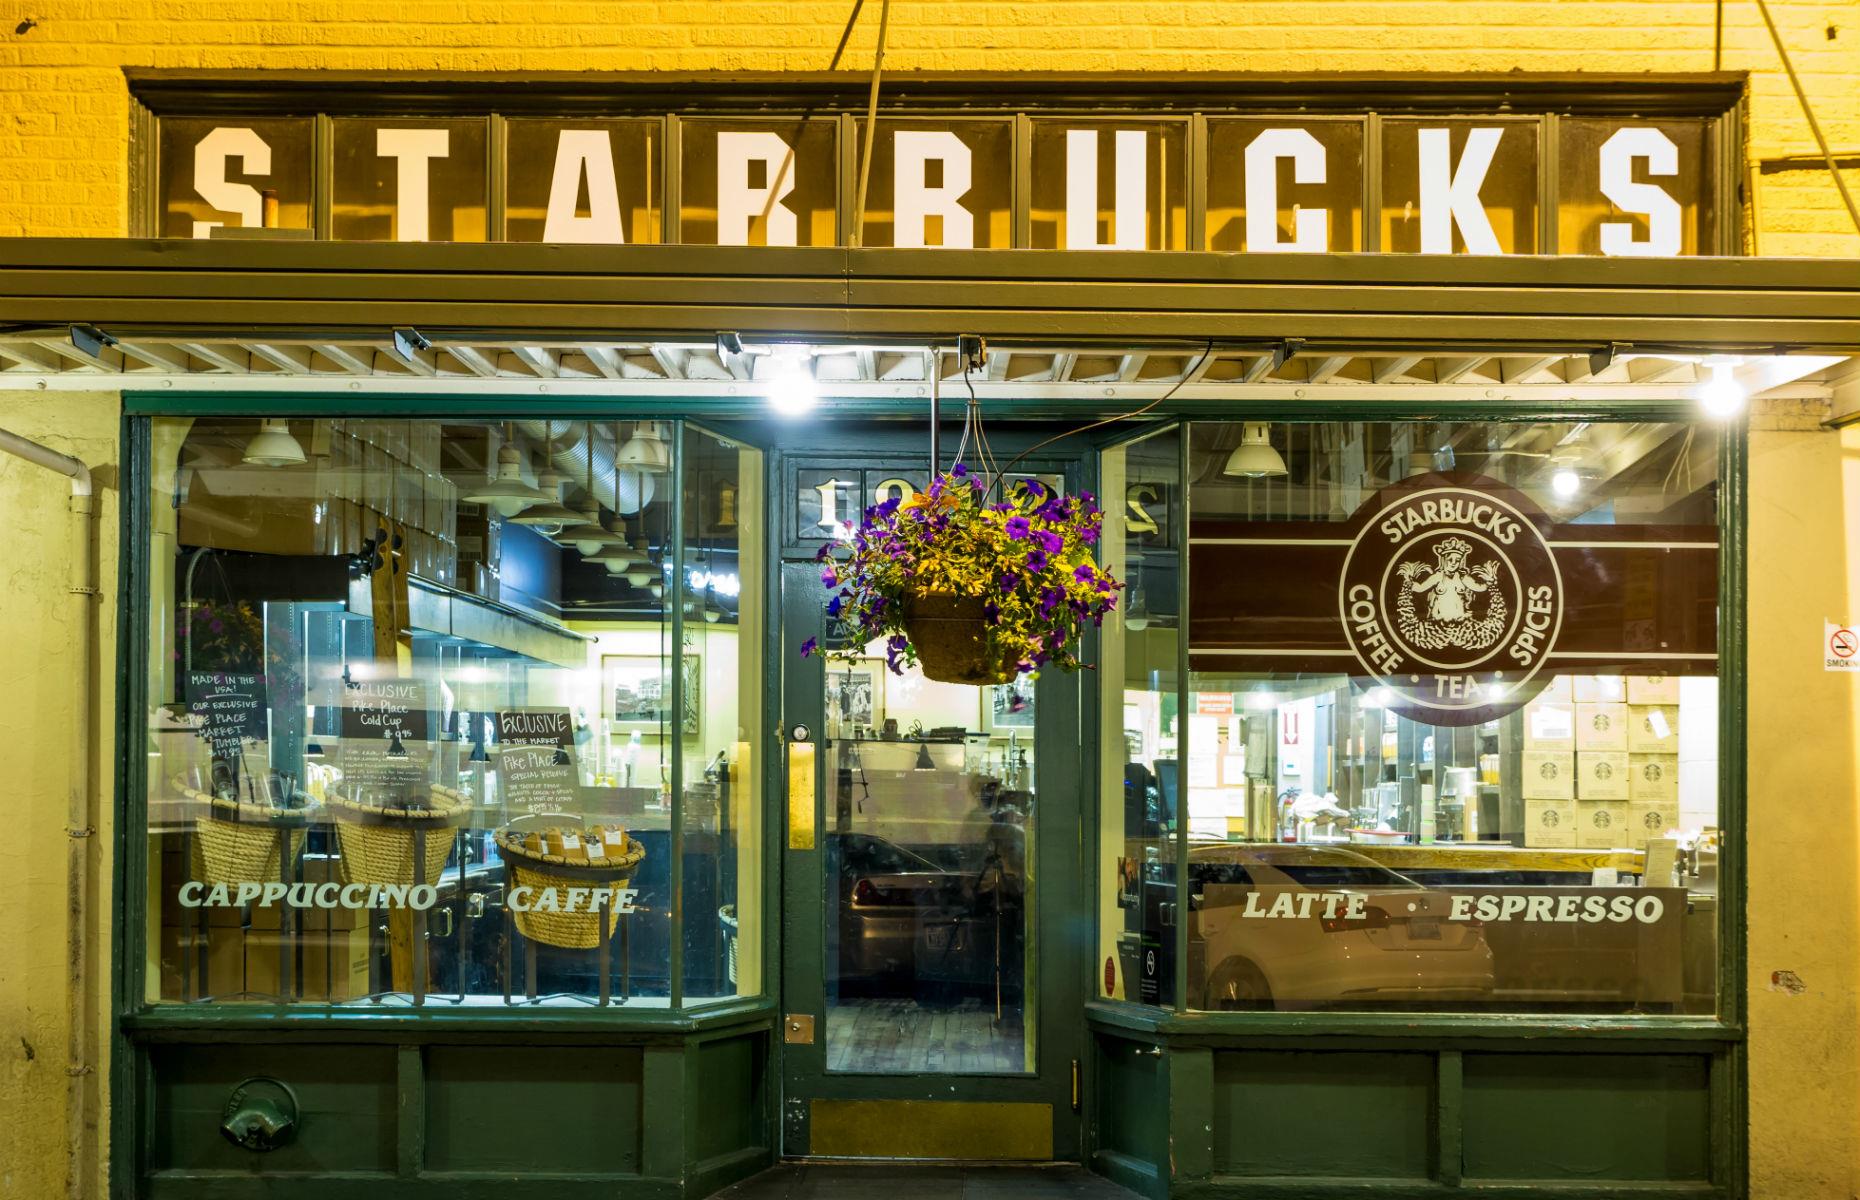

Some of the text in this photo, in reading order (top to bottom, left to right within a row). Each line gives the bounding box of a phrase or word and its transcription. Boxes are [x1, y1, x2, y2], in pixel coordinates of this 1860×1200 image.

[193, 127, 1682, 257] STARBUCKS
[1381, 498, 1522, 545] STARBUCKS
[1349, 584, 1553, 699] COFFEE TEA SPICES
[191, 675, 256, 685] MADE IN THE
[345, 682, 418, 699] EXCLUSIVE
[192, 700, 258, 711] OUR EXCLUSIVE
[380, 699, 409, 714] Place
[215, 713, 247, 724] PLACE
[360, 713, 402, 730] Cold Cup
[198, 725, 246, 738] MARKET
[501, 738, 510, 746] TO
[530, 736, 560, 744] MARKET
[503, 755, 527, 771] Pike
[178, 881, 639, 915] CAPPUCCINO CAFFE
[1242, 892, 1665, 924] LATTE ESPRESSO
